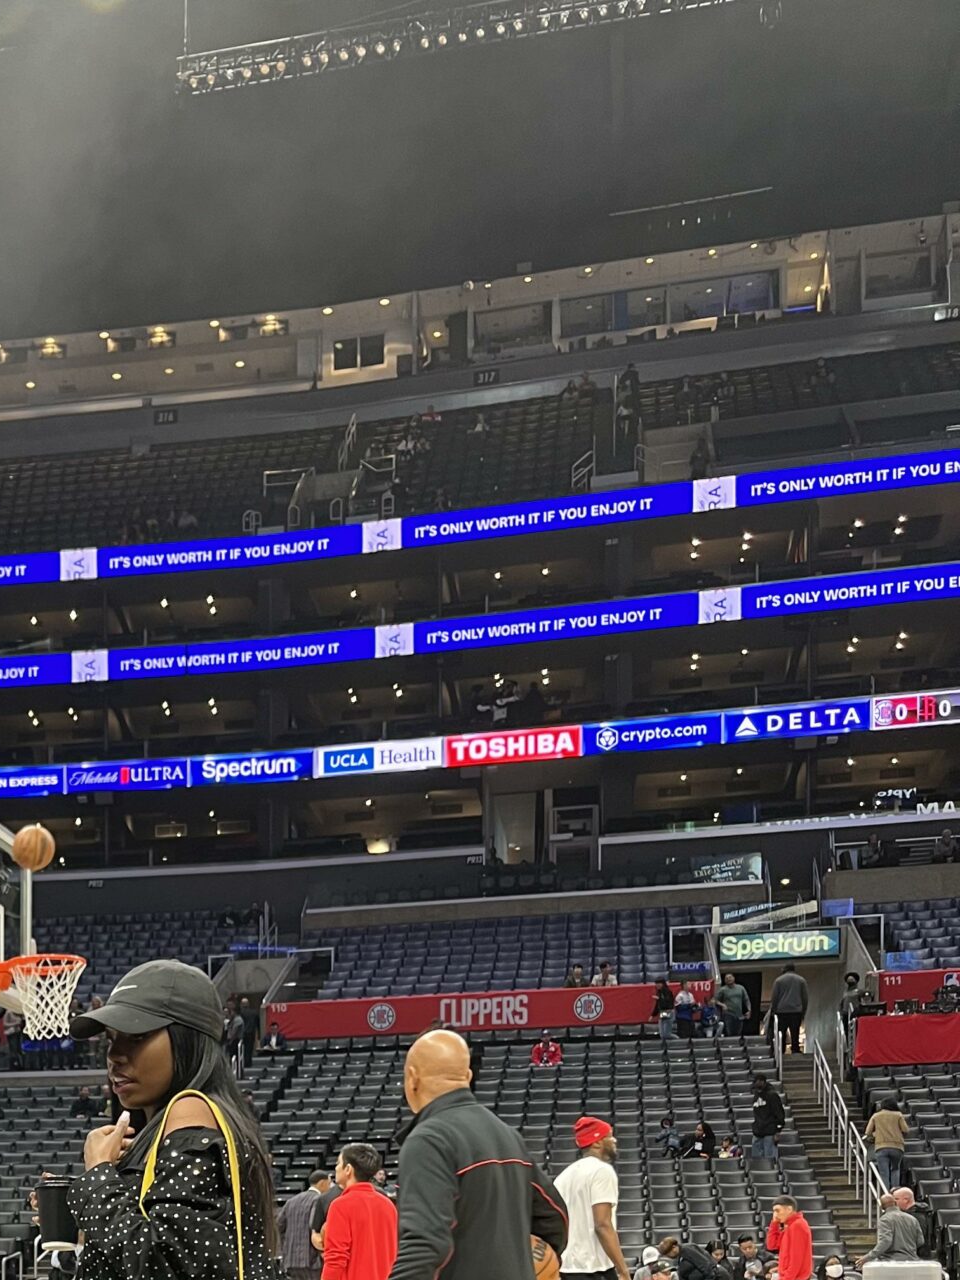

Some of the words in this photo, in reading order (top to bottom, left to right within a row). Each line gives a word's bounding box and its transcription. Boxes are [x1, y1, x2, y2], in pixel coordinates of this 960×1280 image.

[750, 482, 776, 497] IT'S
[778, 477, 816, 493] ONLY
[818, 470, 873, 489] WORTH
[876, 468, 890, 482] IT
[892, 466, 906, 480] IF
[909, 462, 941, 478] YOU
[414, 524, 438, 539] IT'S
[439, 520, 474, 536] ONLY
[475, 514, 526, 531] WORTH
[528, 512, 541, 525] IT
[543, 510, 556, 523] IF
[558, 506, 588, 521] YOU
[590, 499, 637, 517] ENJOY
[639, 497, 654, 511] IT
[109, 556, 131, 569] IT'S
[132, 554, 165, 568] ONLY
[166, 550, 213, 565] WORTH
[215, 548, 228, 561] IT
[229, 548, 242, 560] IF
[243, 545, 271, 559] YOU
[273, 539, 315, 556] ENJOY
[317, 538, 330, 551] IT
[15, 564, 27, 577] IT
[756, 594, 781, 609] IT'S
[783, 590, 821, 606] ONLY
[823, 584, 877, 602] WORTH
[880, 582, 894, 596] IT
[896, 580, 911, 594] IF
[913, 577, 945, 592] YOU
[426, 630, 450, 645] IT'S
[451, 627, 485, 642] ONLY
[487, 621, 536, 638] WORTH
[539, 620, 552, 633] IT
[553, 618, 566, 631] IF
[568, 615, 598, 629] YOU
[600, 609, 646, 626] ENJOY
[649, 607, 663, 621] IT
[120, 658, 142, 672] IT'S
[143, 657, 175, 670] ONLY
[176, 653, 226, 668] WORTH
[227, 652, 239, 664] IT
[241, 651, 253, 663] IF
[255, 648, 282, 662] YOU
[284, 644, 325, 659] ENJOY
[327, 642, 340, 655] IT
[27, 666, 40, 678] IT
[767, 706, 861, 732] DELTA
[894, 703, 908, 720] 0
[939, 700, 952, 717] 0
[451, 731, 575, 760] TOSHIBA
[620, 722, 708, 743] crypto.com
[330, 753, 369, 769] UCLA
[379, 743, 437, 766] Health
[9, 774, 59, 789] EXPRESS
[130, 765, 184, 784] ULTRA
[202, 756, 297, 783] Spectrum
[721, 933, 829, 960] Spectrum
[694, 981, 711, 991] 110
[883, 976, 902, 986] 111
[271, 1003, 287, 1013] 110
[440, 994, 529, 1028] CLIPPERS
